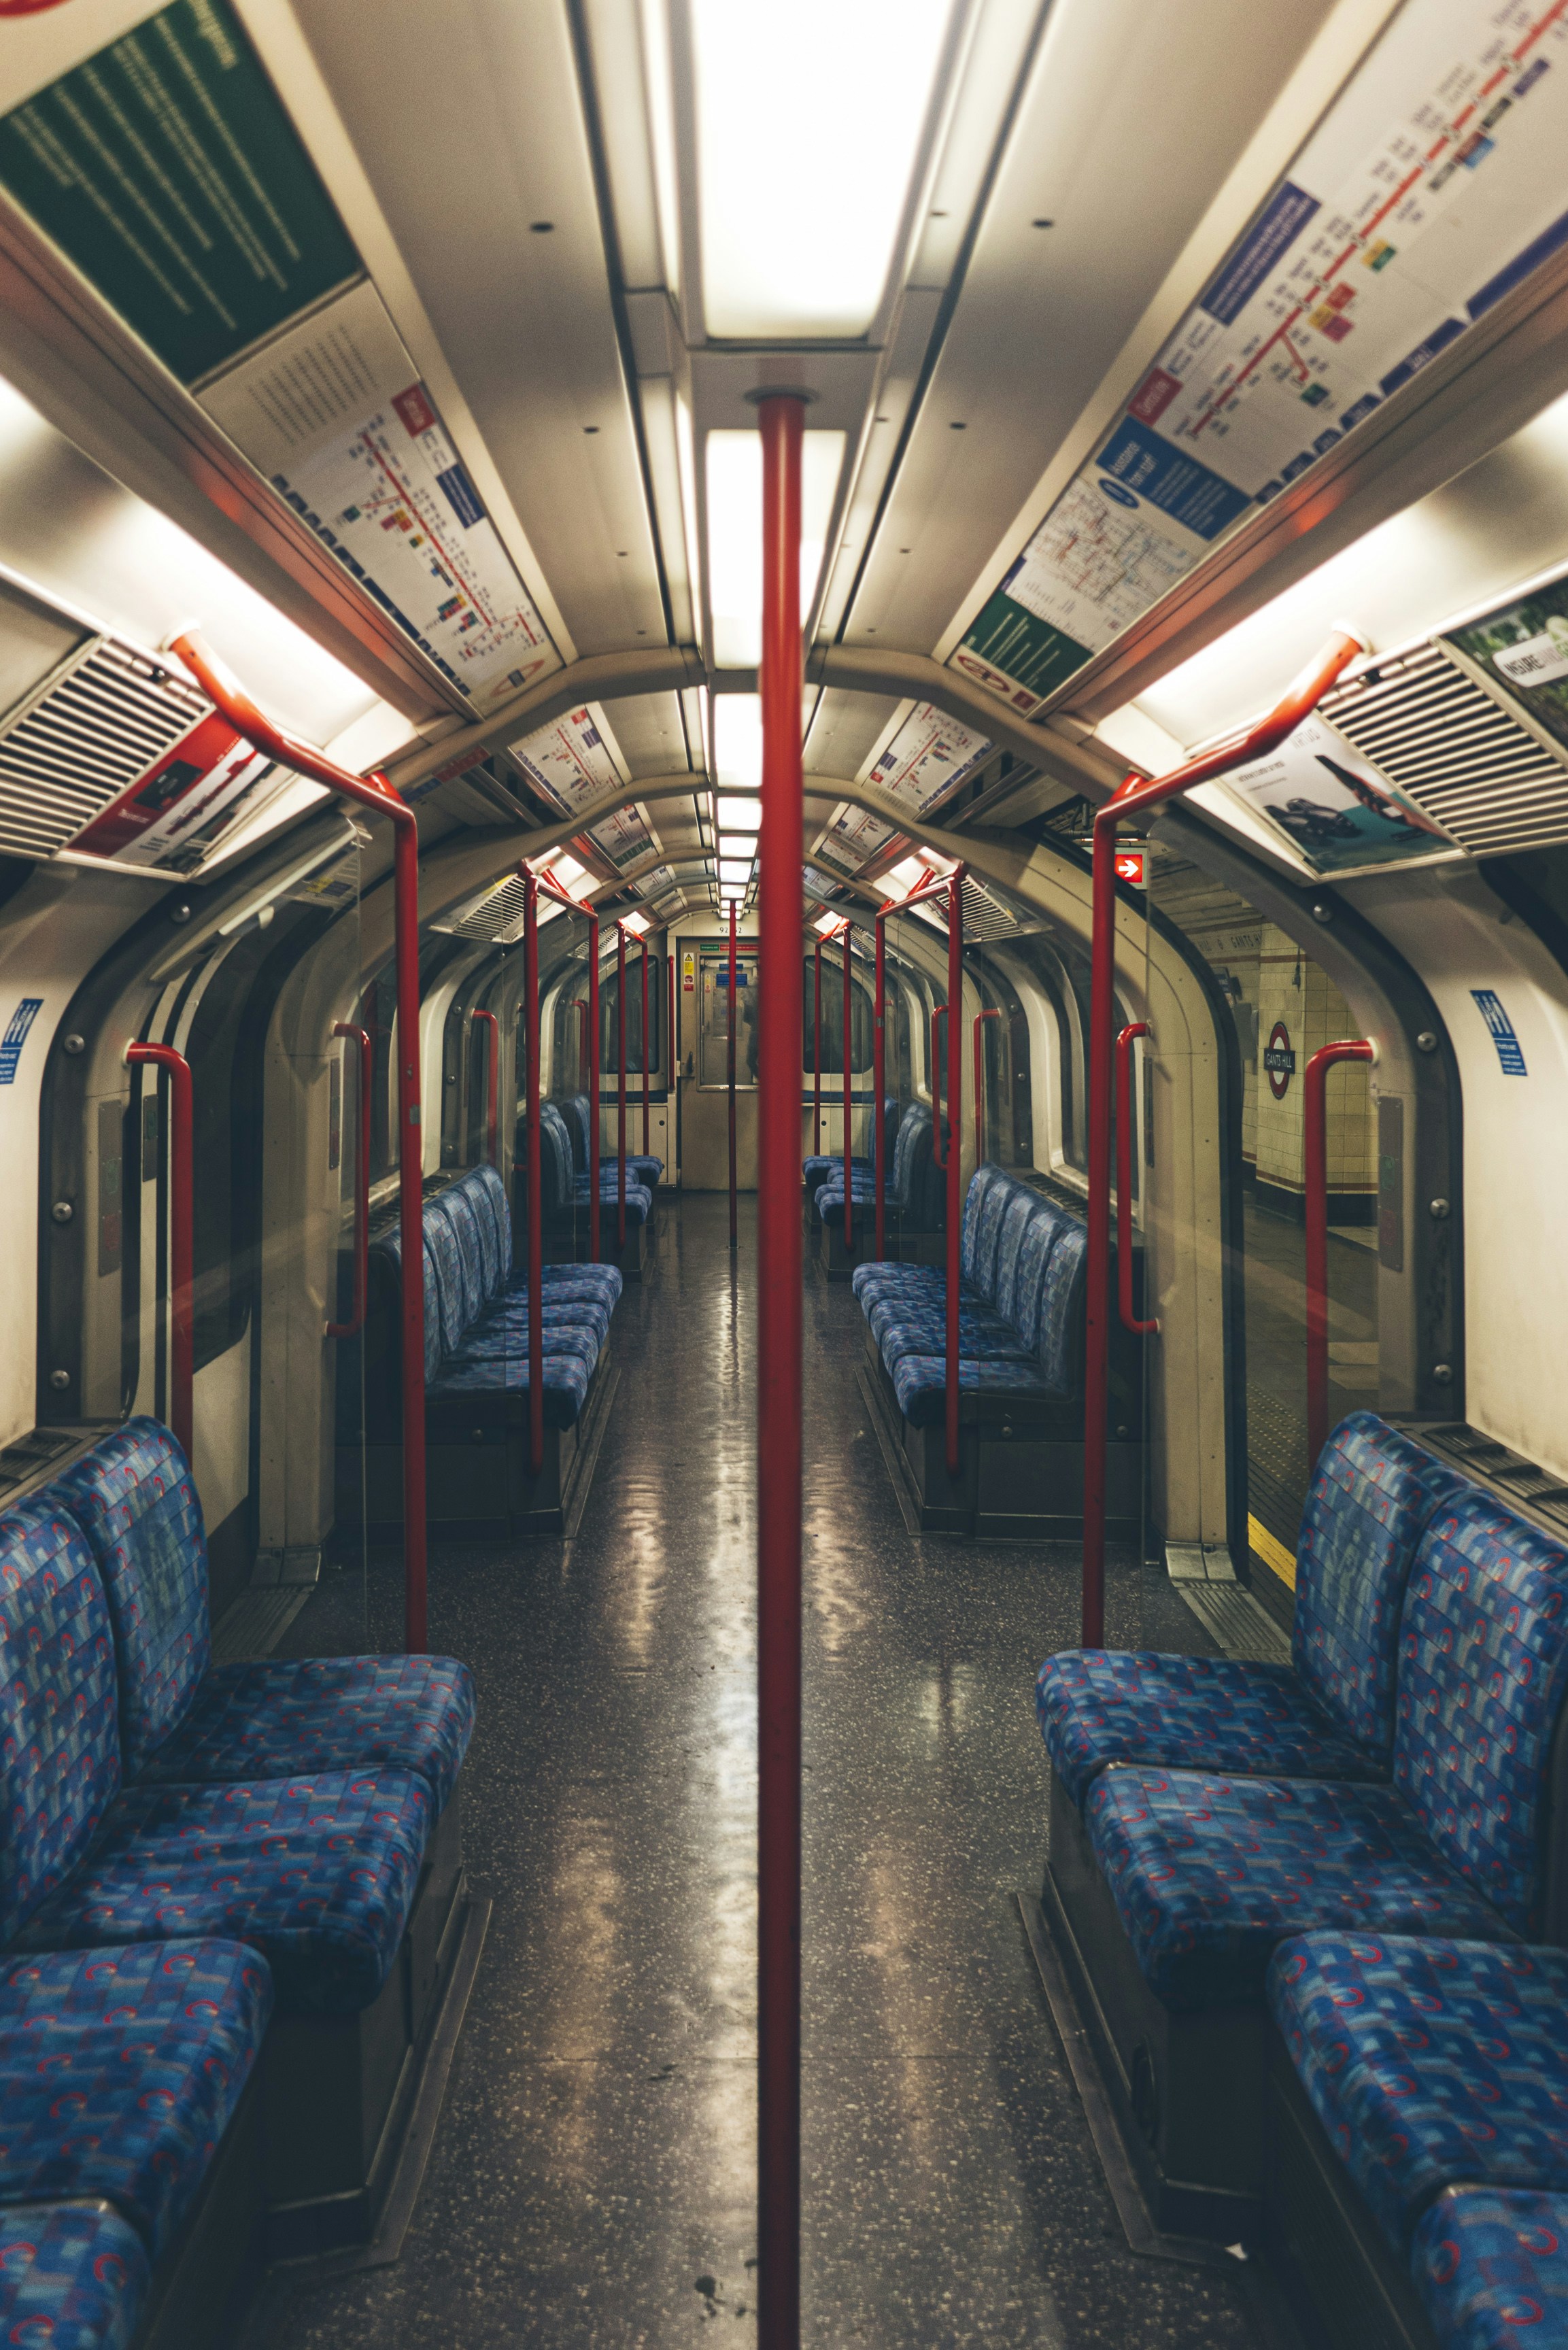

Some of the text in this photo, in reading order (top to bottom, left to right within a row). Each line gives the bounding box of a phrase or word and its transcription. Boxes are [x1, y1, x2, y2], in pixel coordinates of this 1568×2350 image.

[1231, 935, 1254, 949] GANTS
[1267, 1053, 1292, 1068] GANTS HILL
